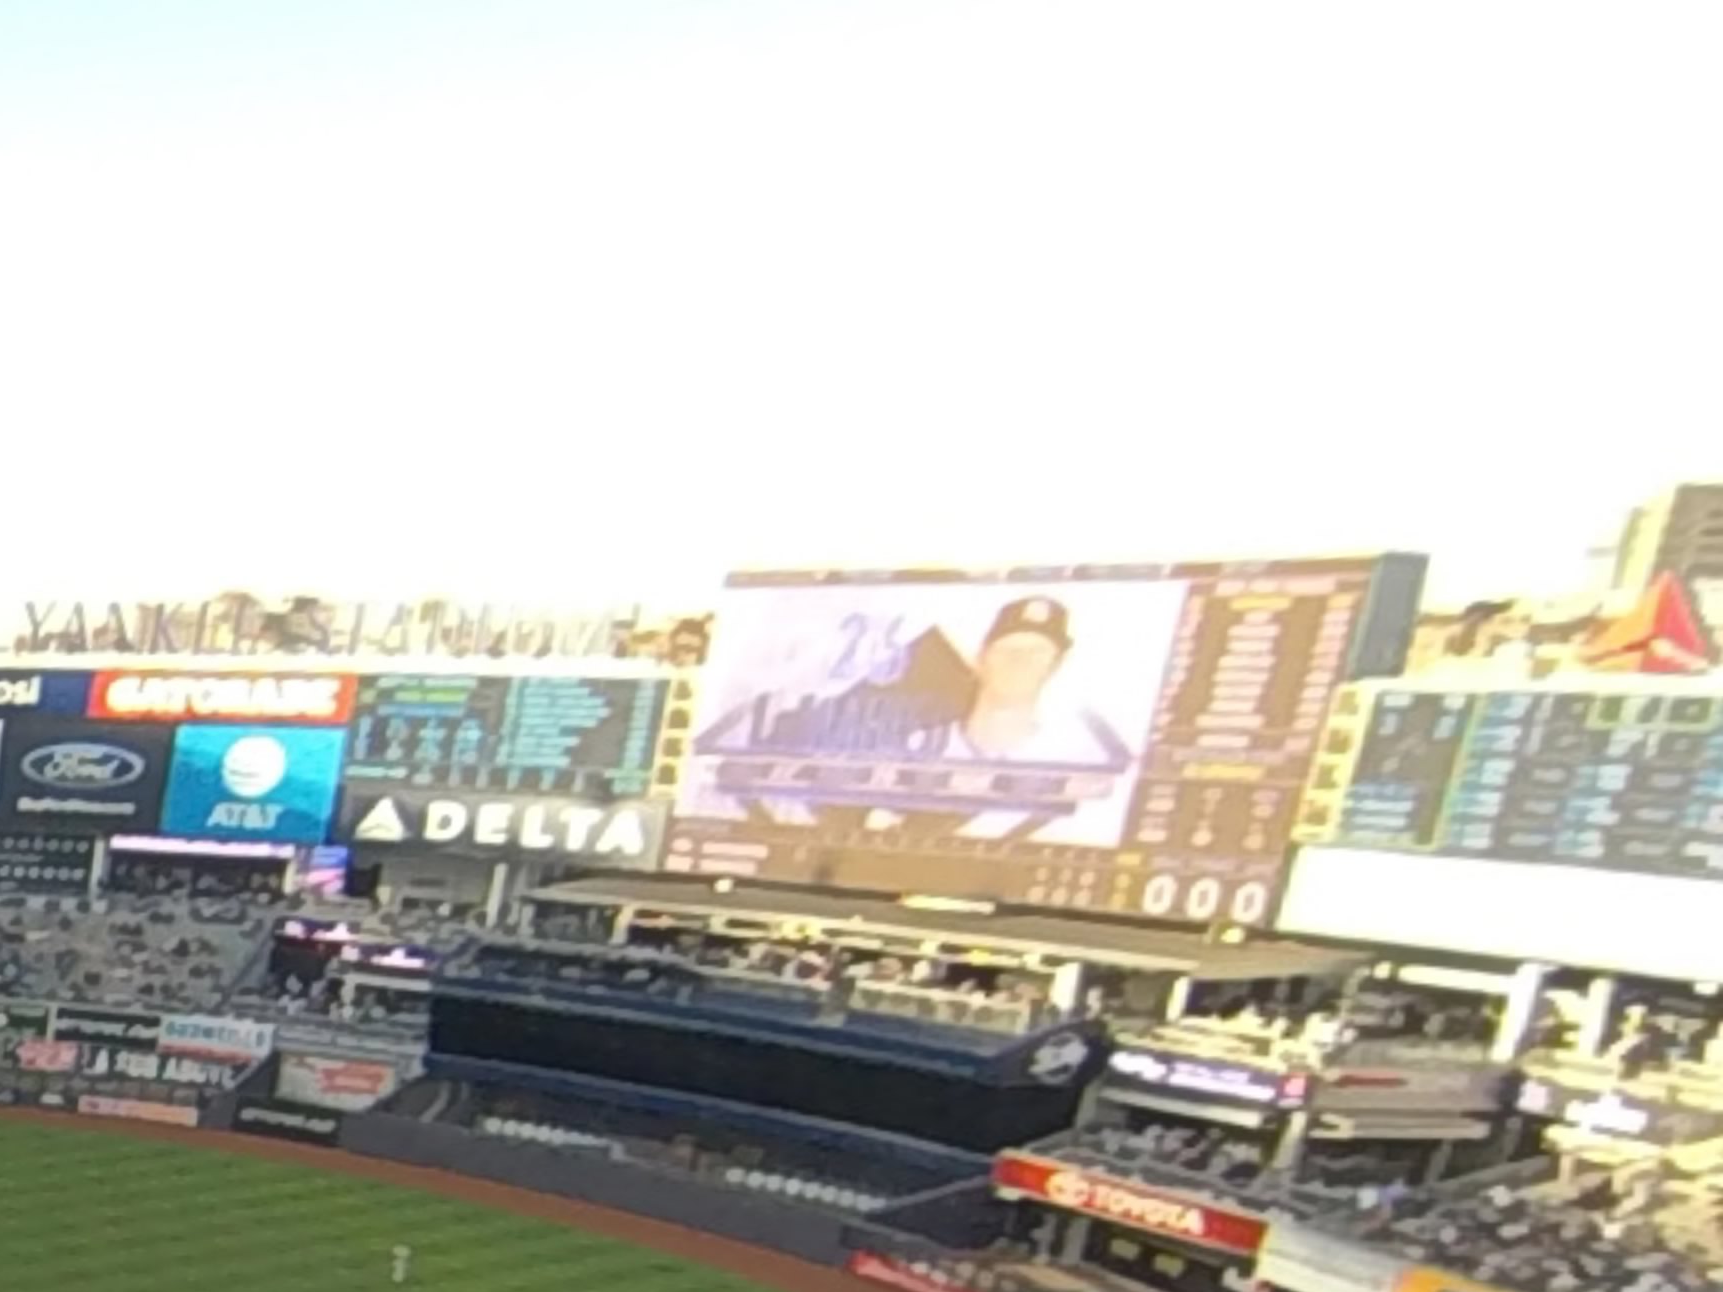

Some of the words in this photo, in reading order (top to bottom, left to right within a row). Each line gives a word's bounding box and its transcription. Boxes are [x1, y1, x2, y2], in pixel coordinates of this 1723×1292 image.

[206, 802, 285, 830] AT&T
[423, 799, 645, 855] DELTA
[1089, 1184, 1205, 1236] TOYOTA
